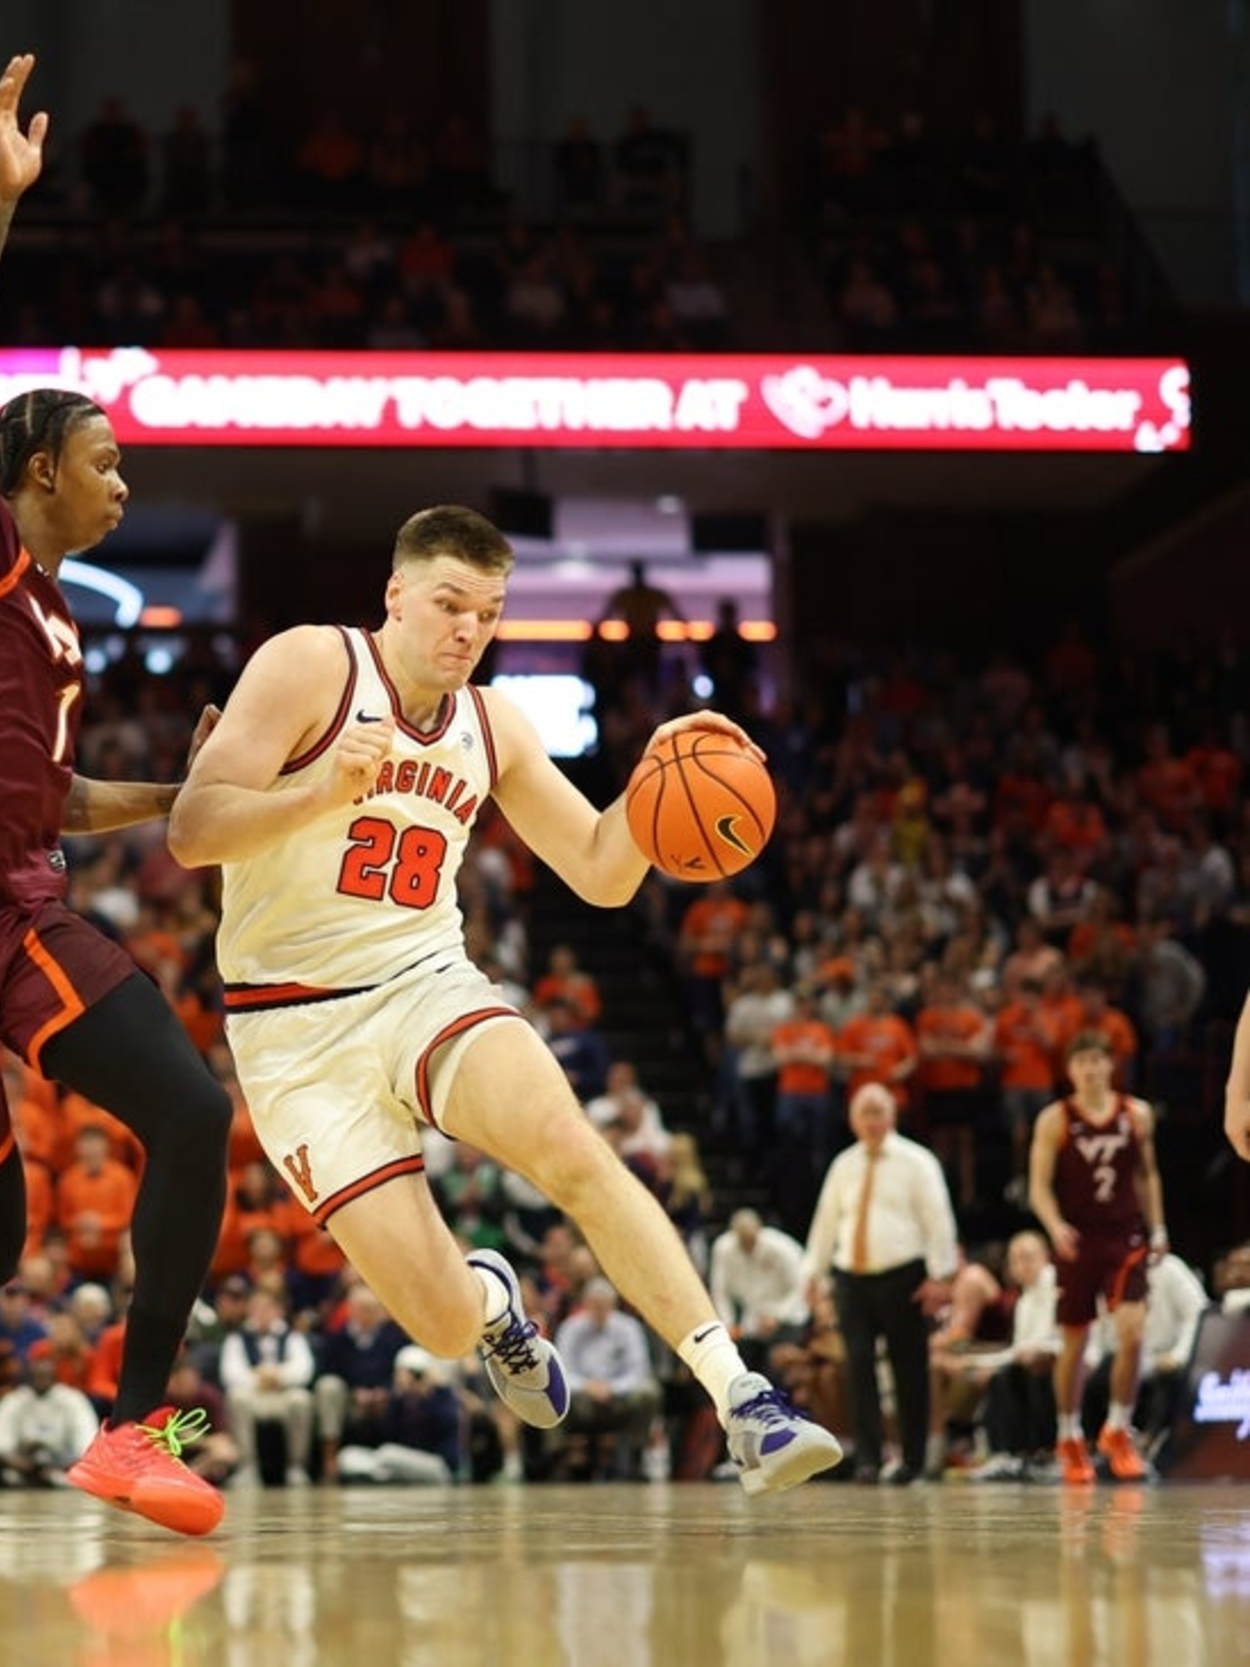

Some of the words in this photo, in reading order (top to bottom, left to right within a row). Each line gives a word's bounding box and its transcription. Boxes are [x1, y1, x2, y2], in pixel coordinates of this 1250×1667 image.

[675, 378, 747, 430] AT
[53, 680, 80, 762] 1
[353, 760, 478, 825] RGINIA
[336, 816, 448, 910] 28
